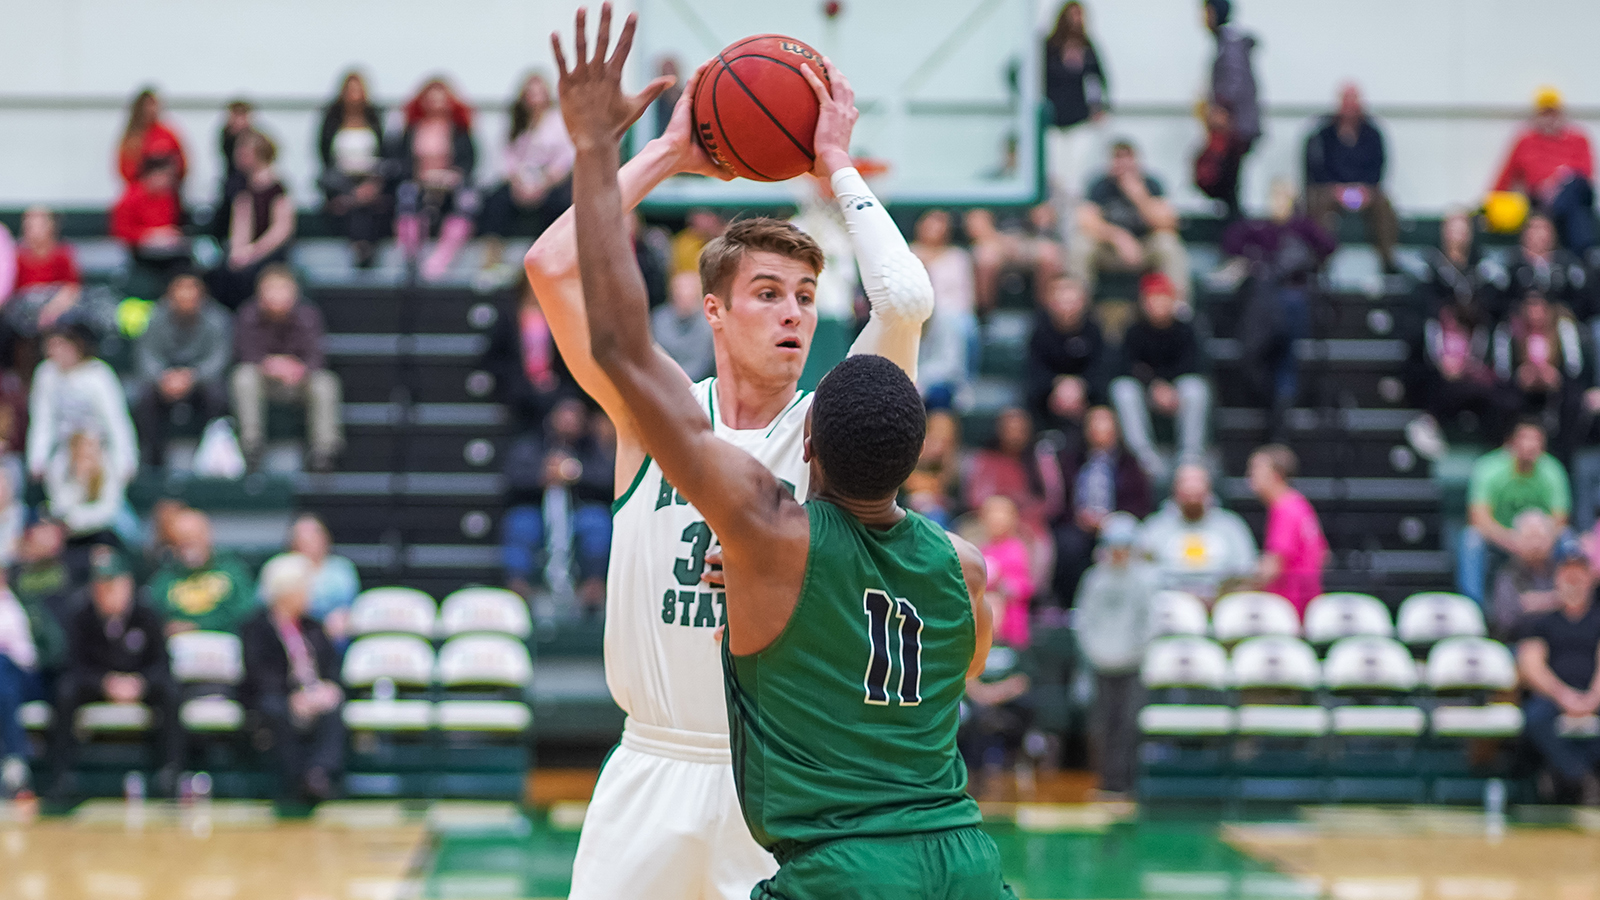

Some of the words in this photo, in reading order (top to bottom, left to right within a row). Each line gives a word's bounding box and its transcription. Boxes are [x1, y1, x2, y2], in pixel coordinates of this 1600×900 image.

[673, 521, 725, 588] 3
[661, 588, 728, 628] STAT
[863, 588, 924, 706] 11
